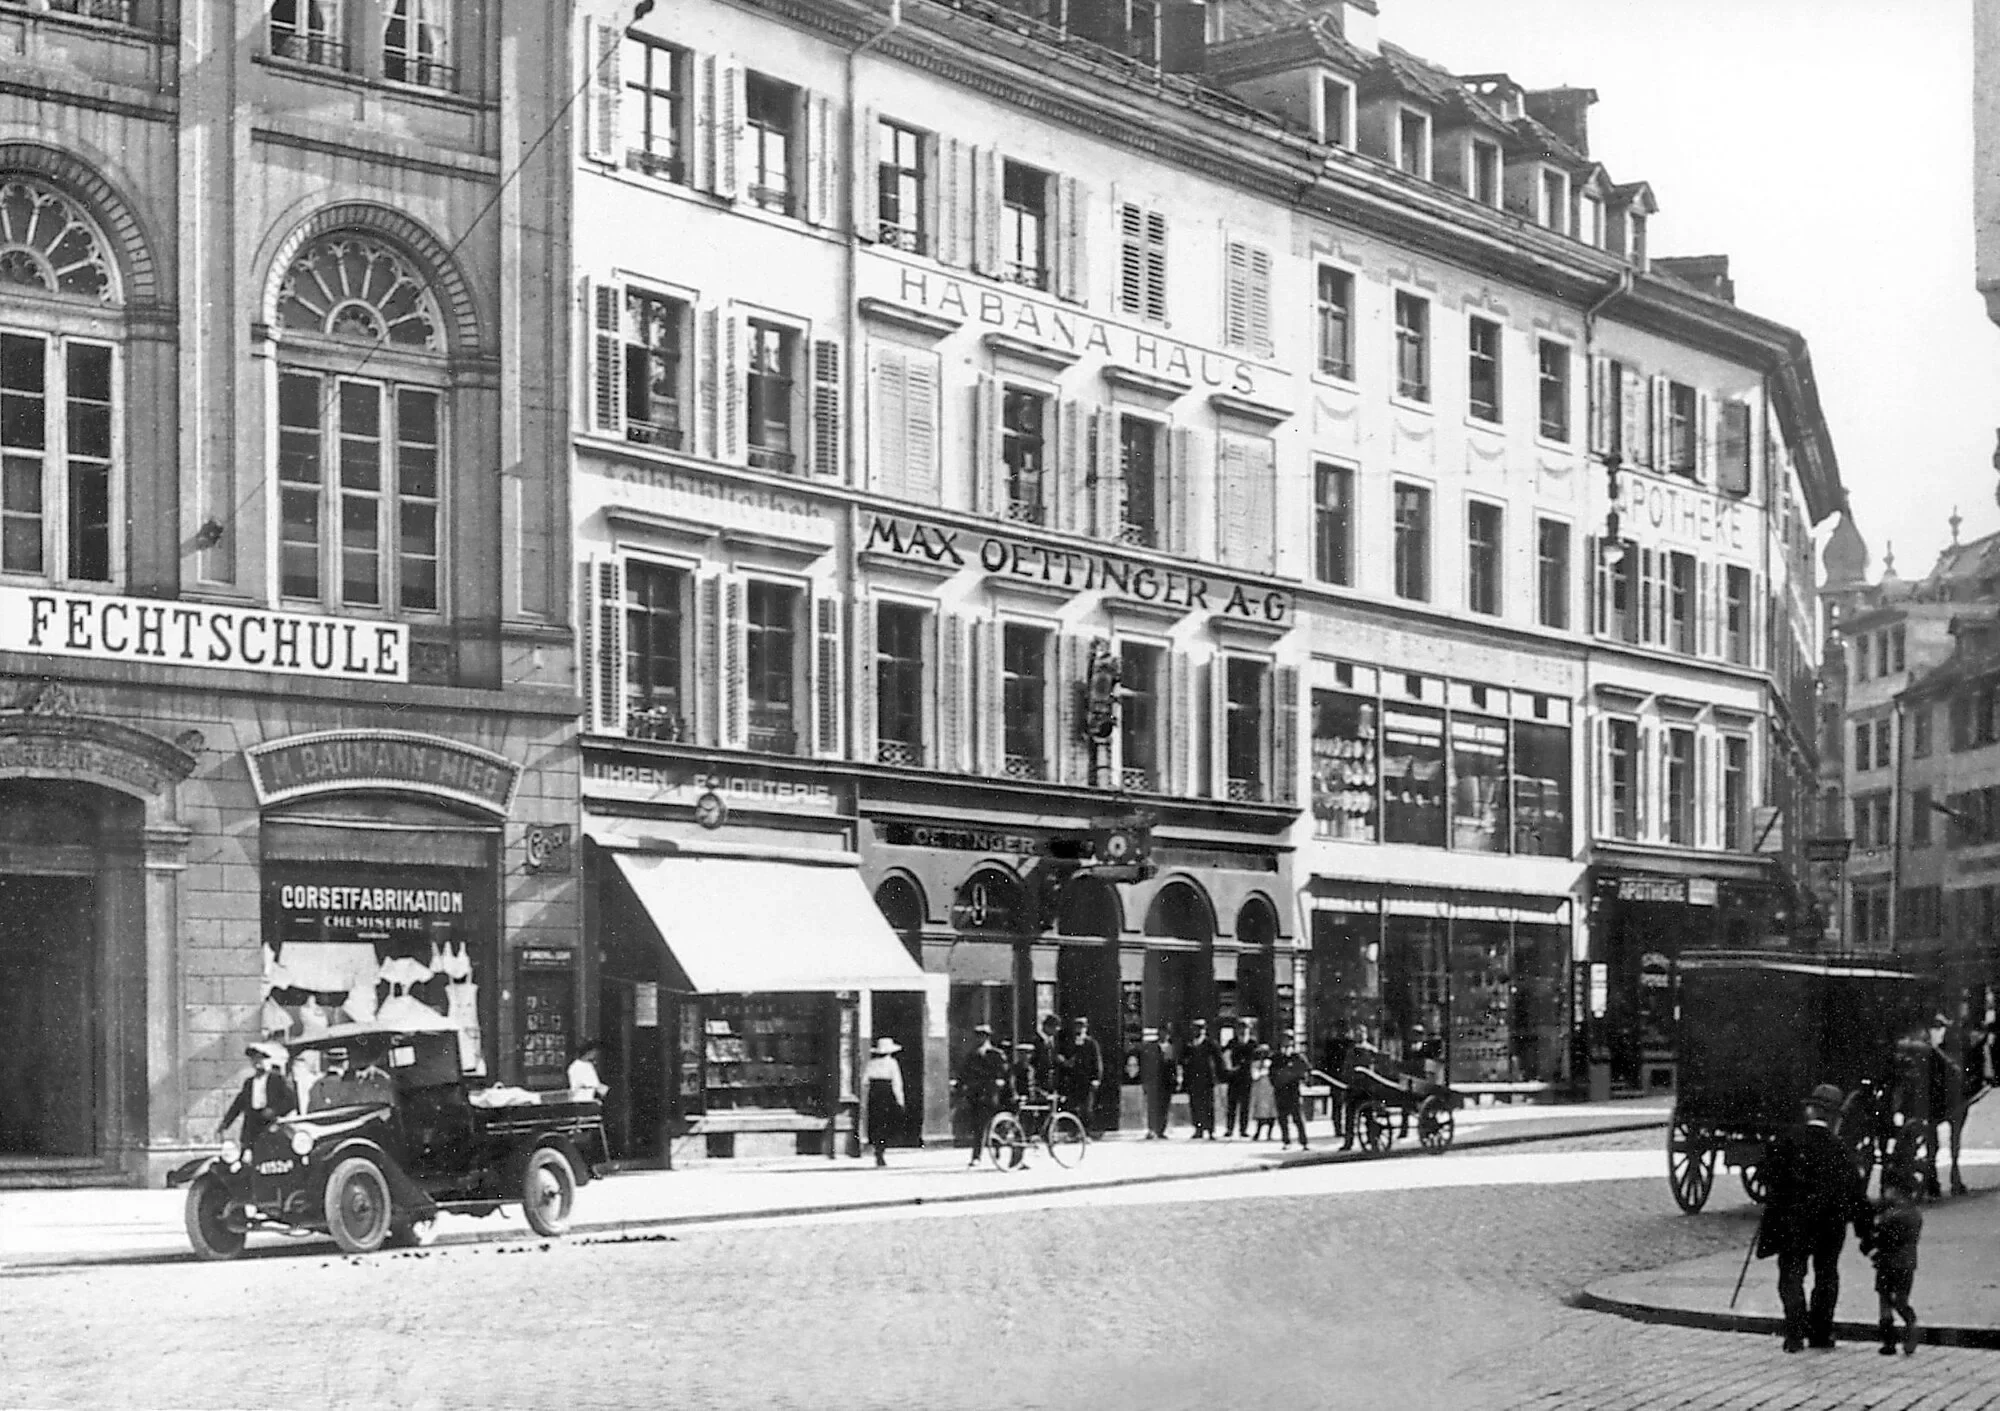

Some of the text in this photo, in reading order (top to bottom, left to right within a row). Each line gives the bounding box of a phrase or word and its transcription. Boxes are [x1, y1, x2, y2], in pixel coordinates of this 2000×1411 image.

[901, 268, 1256, 395] HABANA HAUS
[865, 515, 965, 566] MAX
[980, 538, 1208, 609] OETTINGER
[27, 595, 400, 676] FECHTSCHULE
[693, 773, 831, 803] BJOUTERIE
[281, 884, 463, 913] CORSETFABRIKATION
[323, 914, 424, 931] CHEMISERIE
